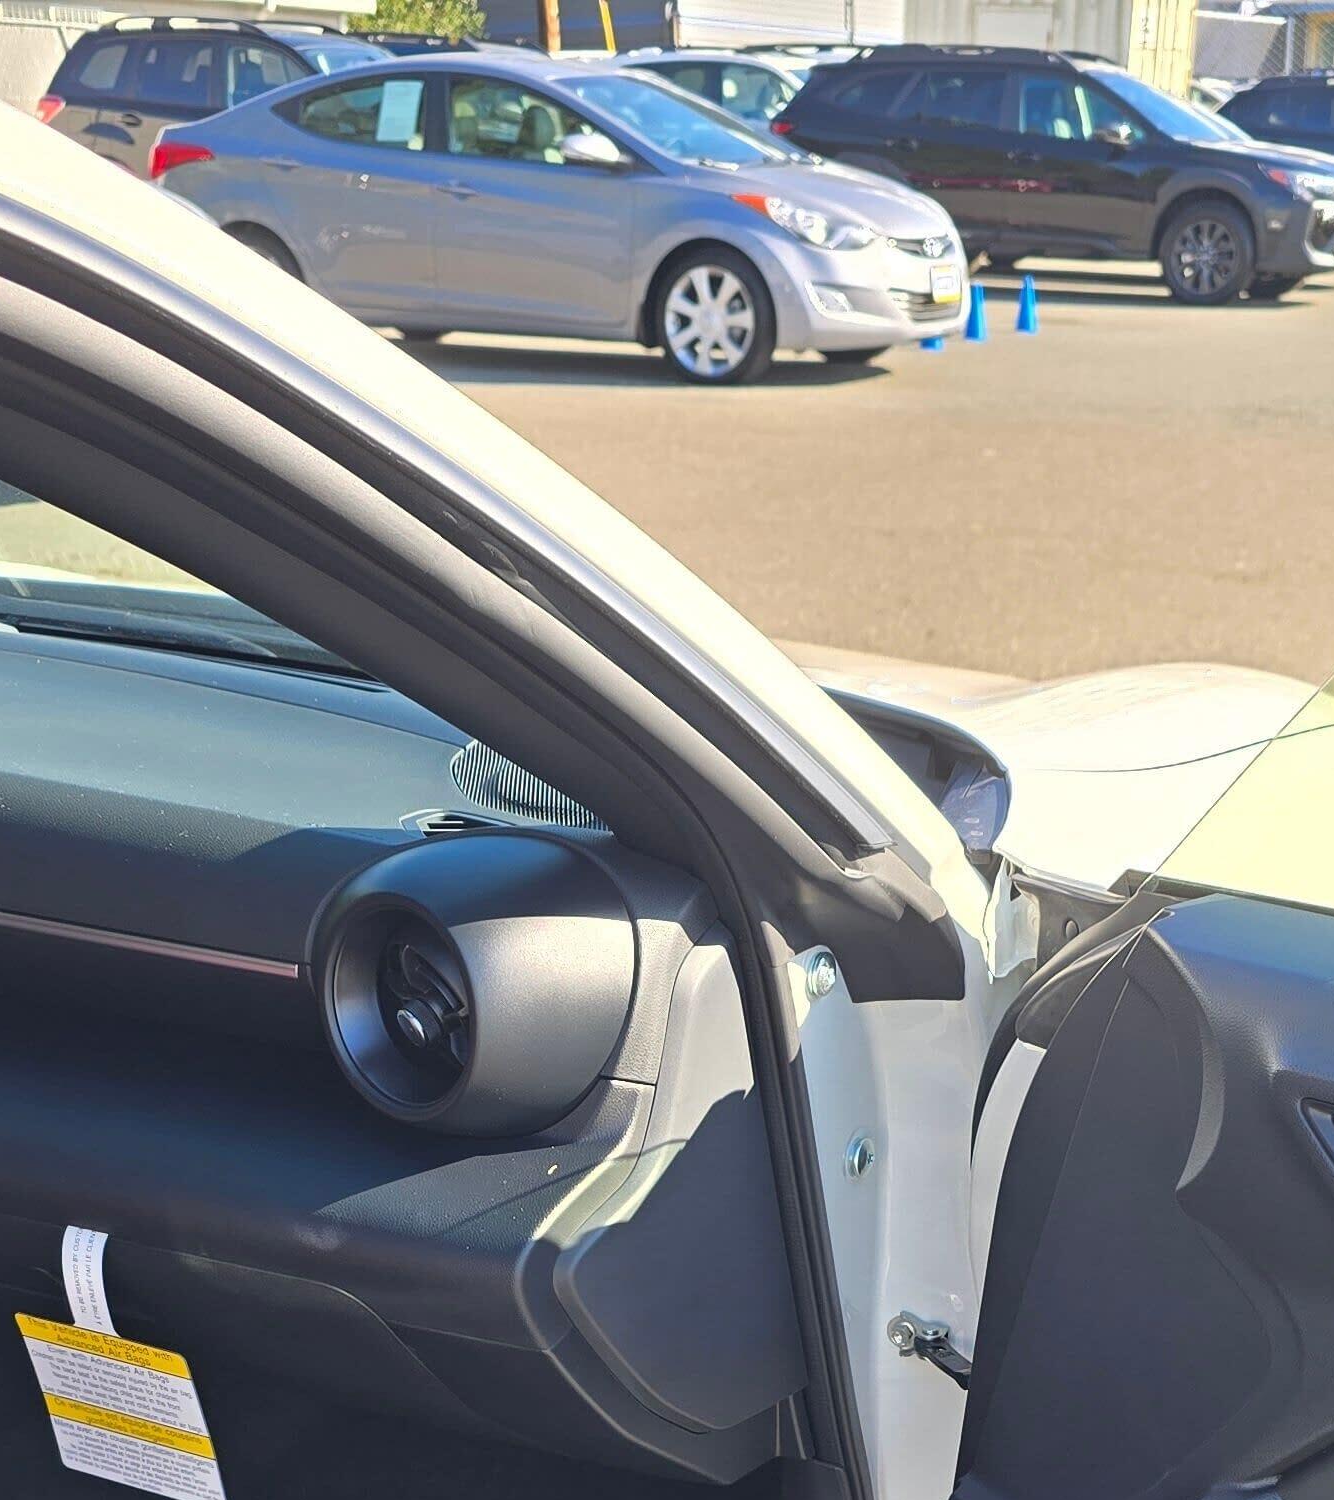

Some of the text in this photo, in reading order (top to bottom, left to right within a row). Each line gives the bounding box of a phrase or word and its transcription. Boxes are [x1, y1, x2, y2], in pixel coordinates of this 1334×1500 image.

[52, 1322, 87, 1339] Vehicle
[91, 1332, 100, 1342] is
[103, 1335, 149, 1355] Equipped
[152, 1350, 173, 1362] with
[57, 1334, 151, 1366] Advanced Air Bags
[91, 1356, 131, 1373] Advanced
[134, 1367, 144, 1375] Air
[148, 1370, 170, 1384] Bags
